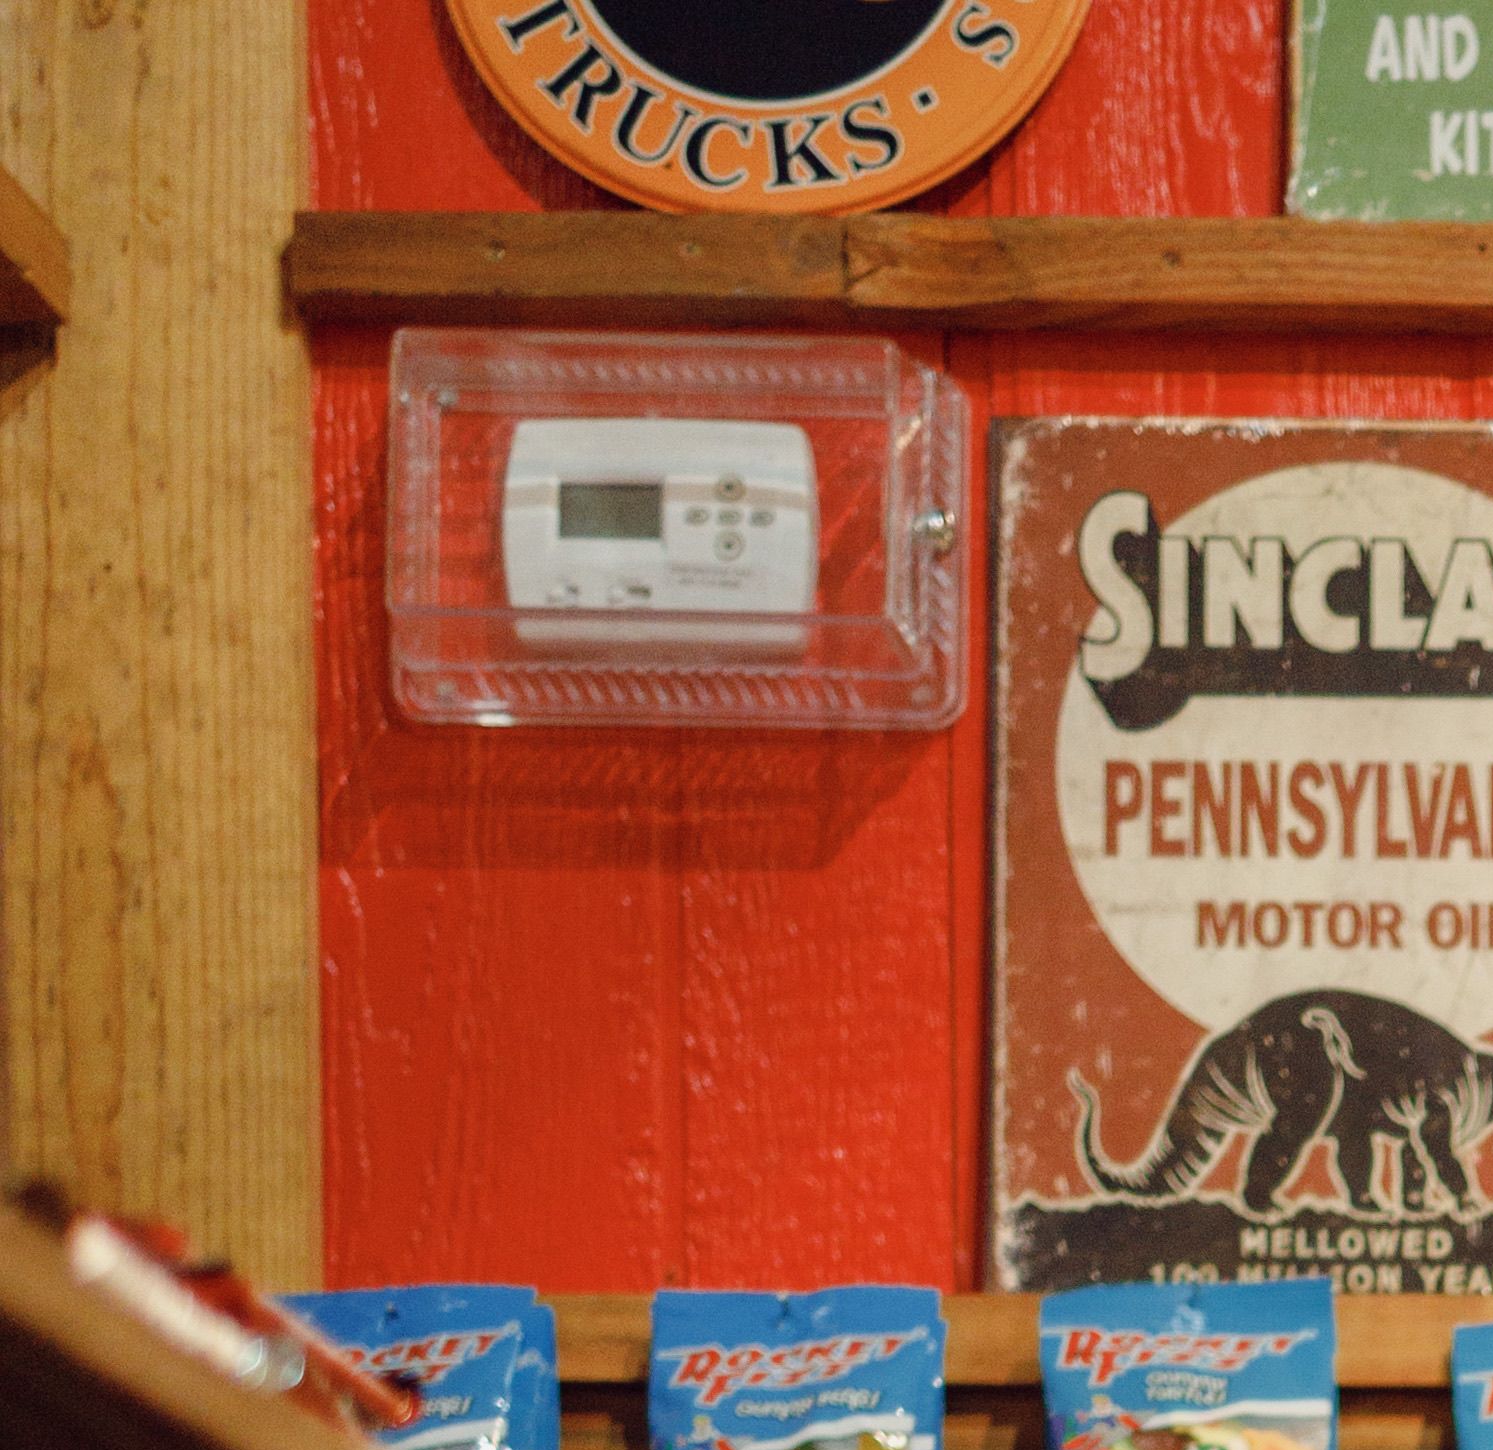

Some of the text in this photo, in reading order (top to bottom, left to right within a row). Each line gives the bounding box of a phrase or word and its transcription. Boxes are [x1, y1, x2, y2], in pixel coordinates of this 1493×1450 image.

[1366, 15, 1480, 82] AND
[500, 0, 901, 190] TRUCKS
[1197, 903, 1402, 951] MOTOR
[1240, 1227, 1454, 1260] MELLOWED
[662, 1332, 912, 1389] ROCKET
[1057, 1330, 1302, 1372] ROCKET
